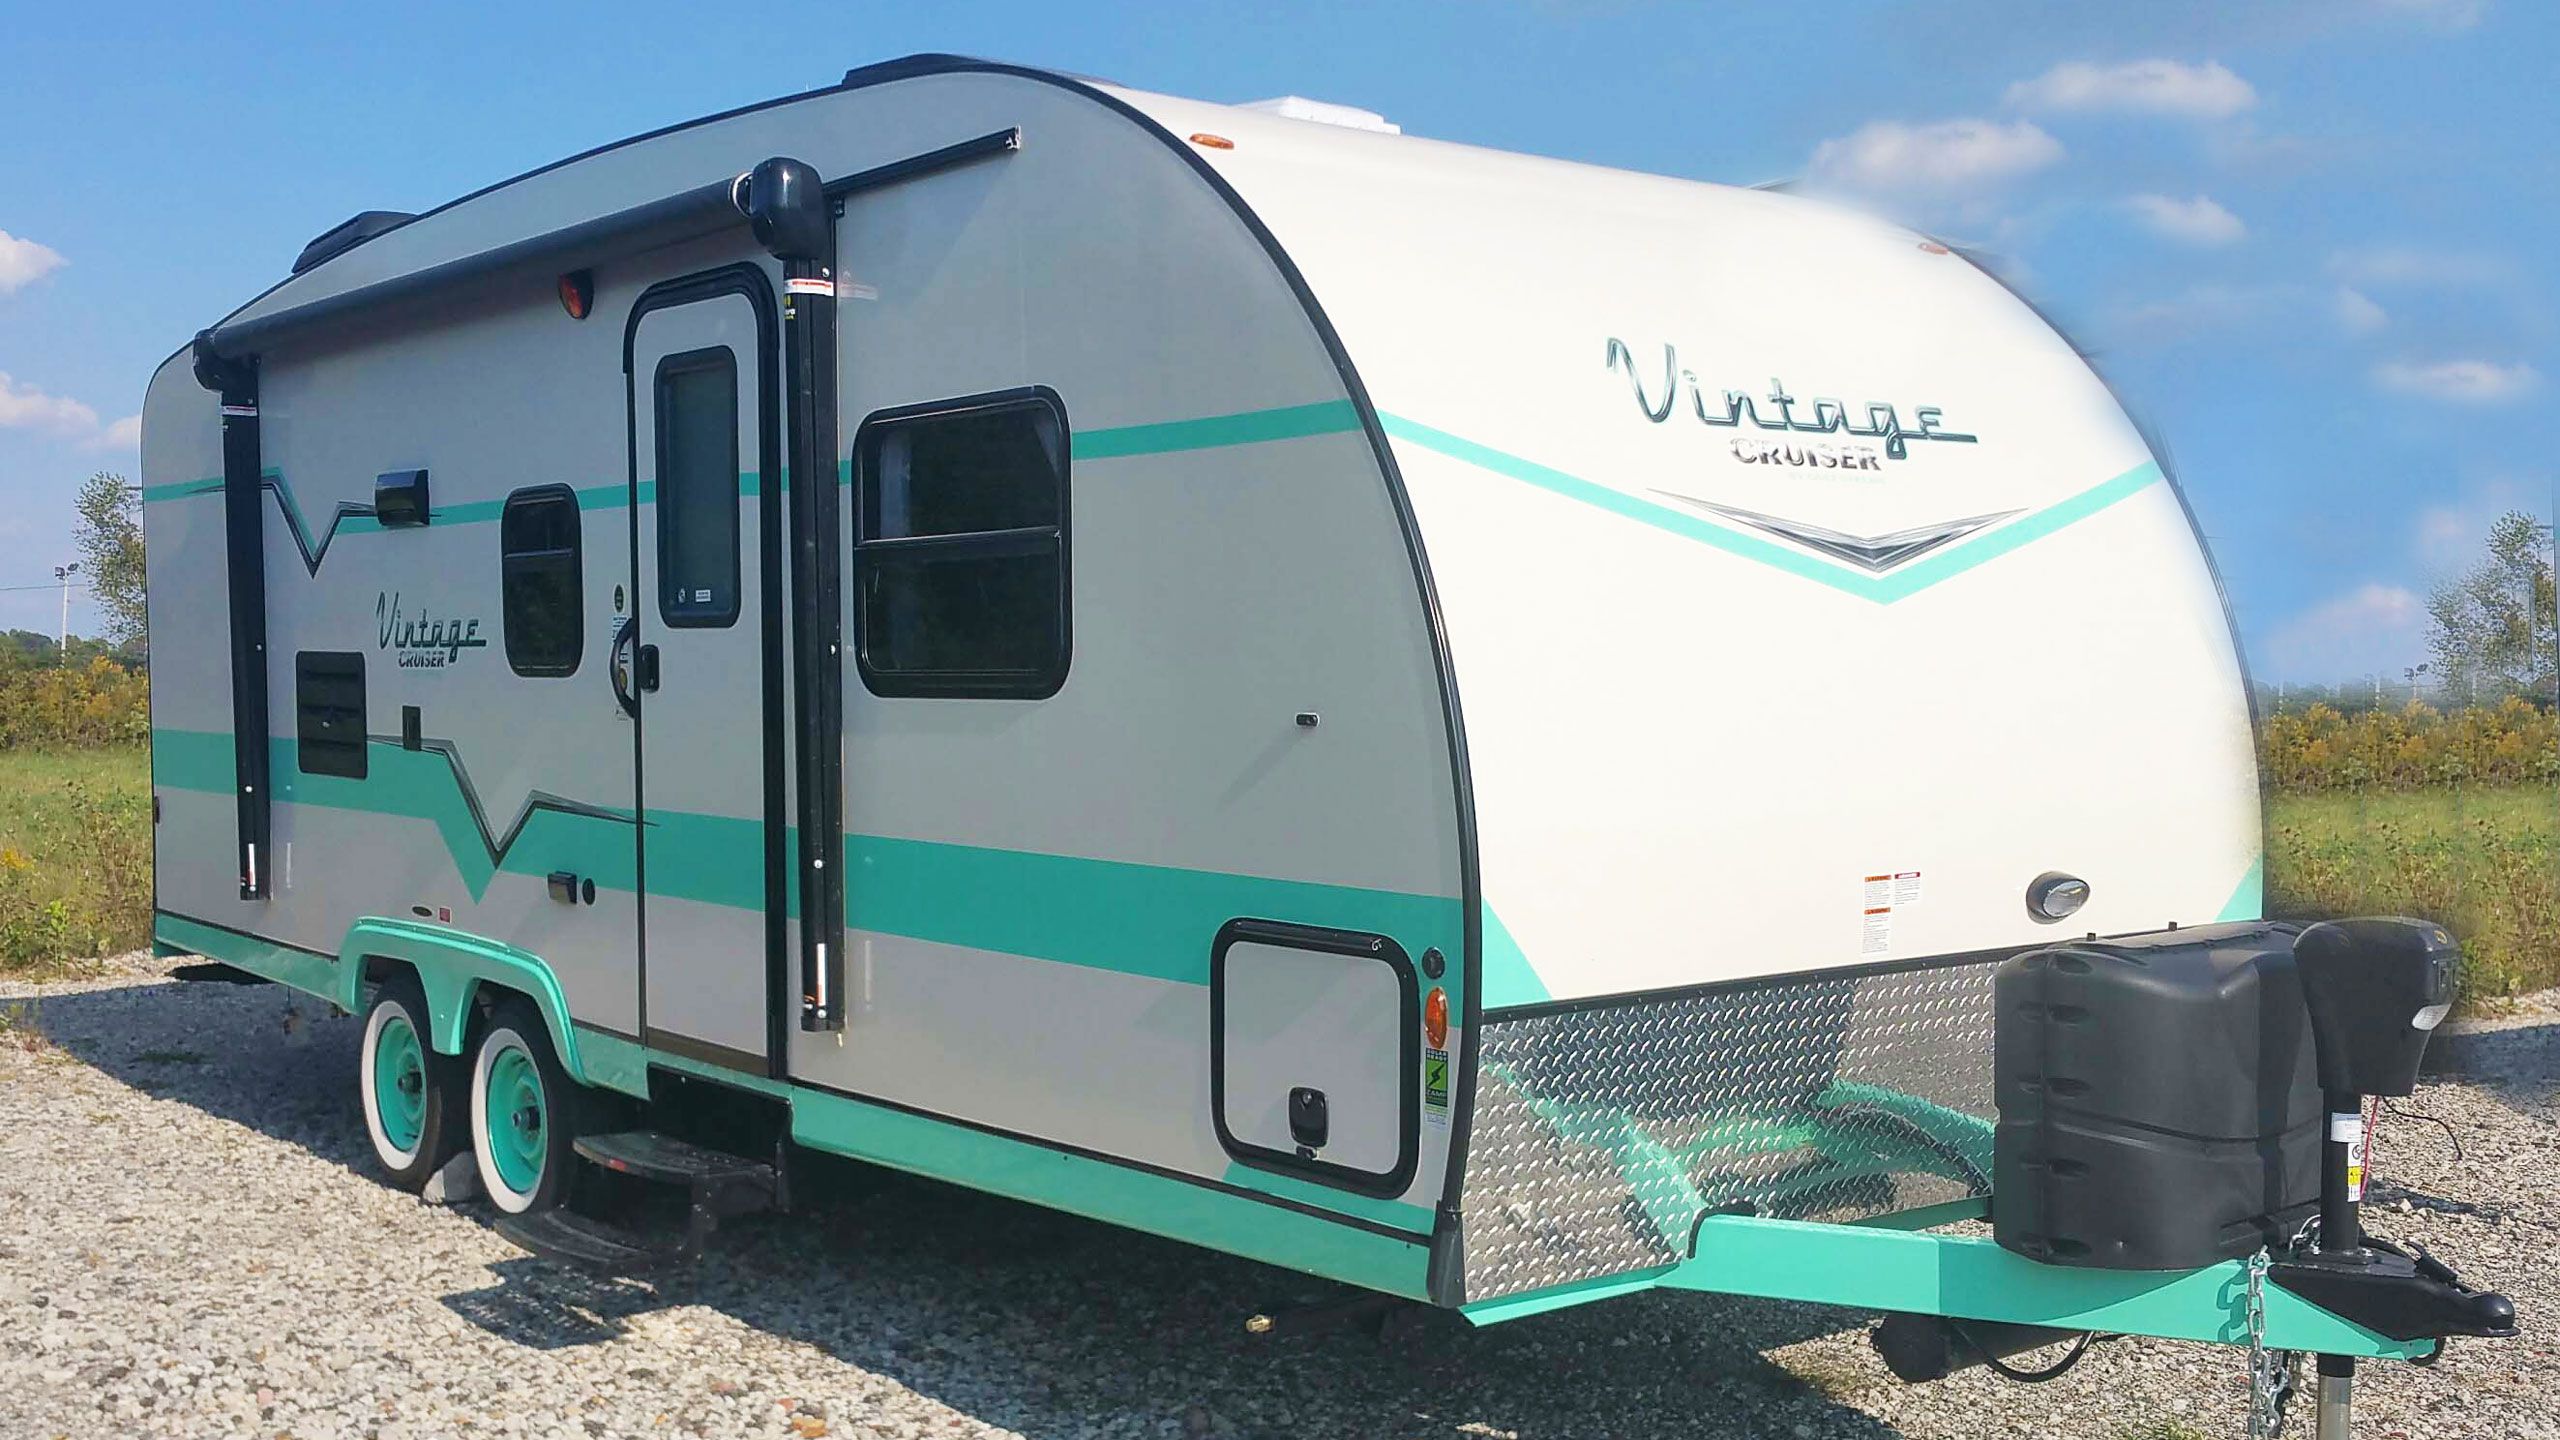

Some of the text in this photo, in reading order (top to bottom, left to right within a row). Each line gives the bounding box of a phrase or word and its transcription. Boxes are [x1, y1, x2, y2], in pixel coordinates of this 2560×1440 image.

[1606, 336, 1978, 460] Vintage
[1730, 438, 1881, 471] CRUISER
[376, 591, 487, 663] Vintage
[399, 651, 445, 667] CRUISER
